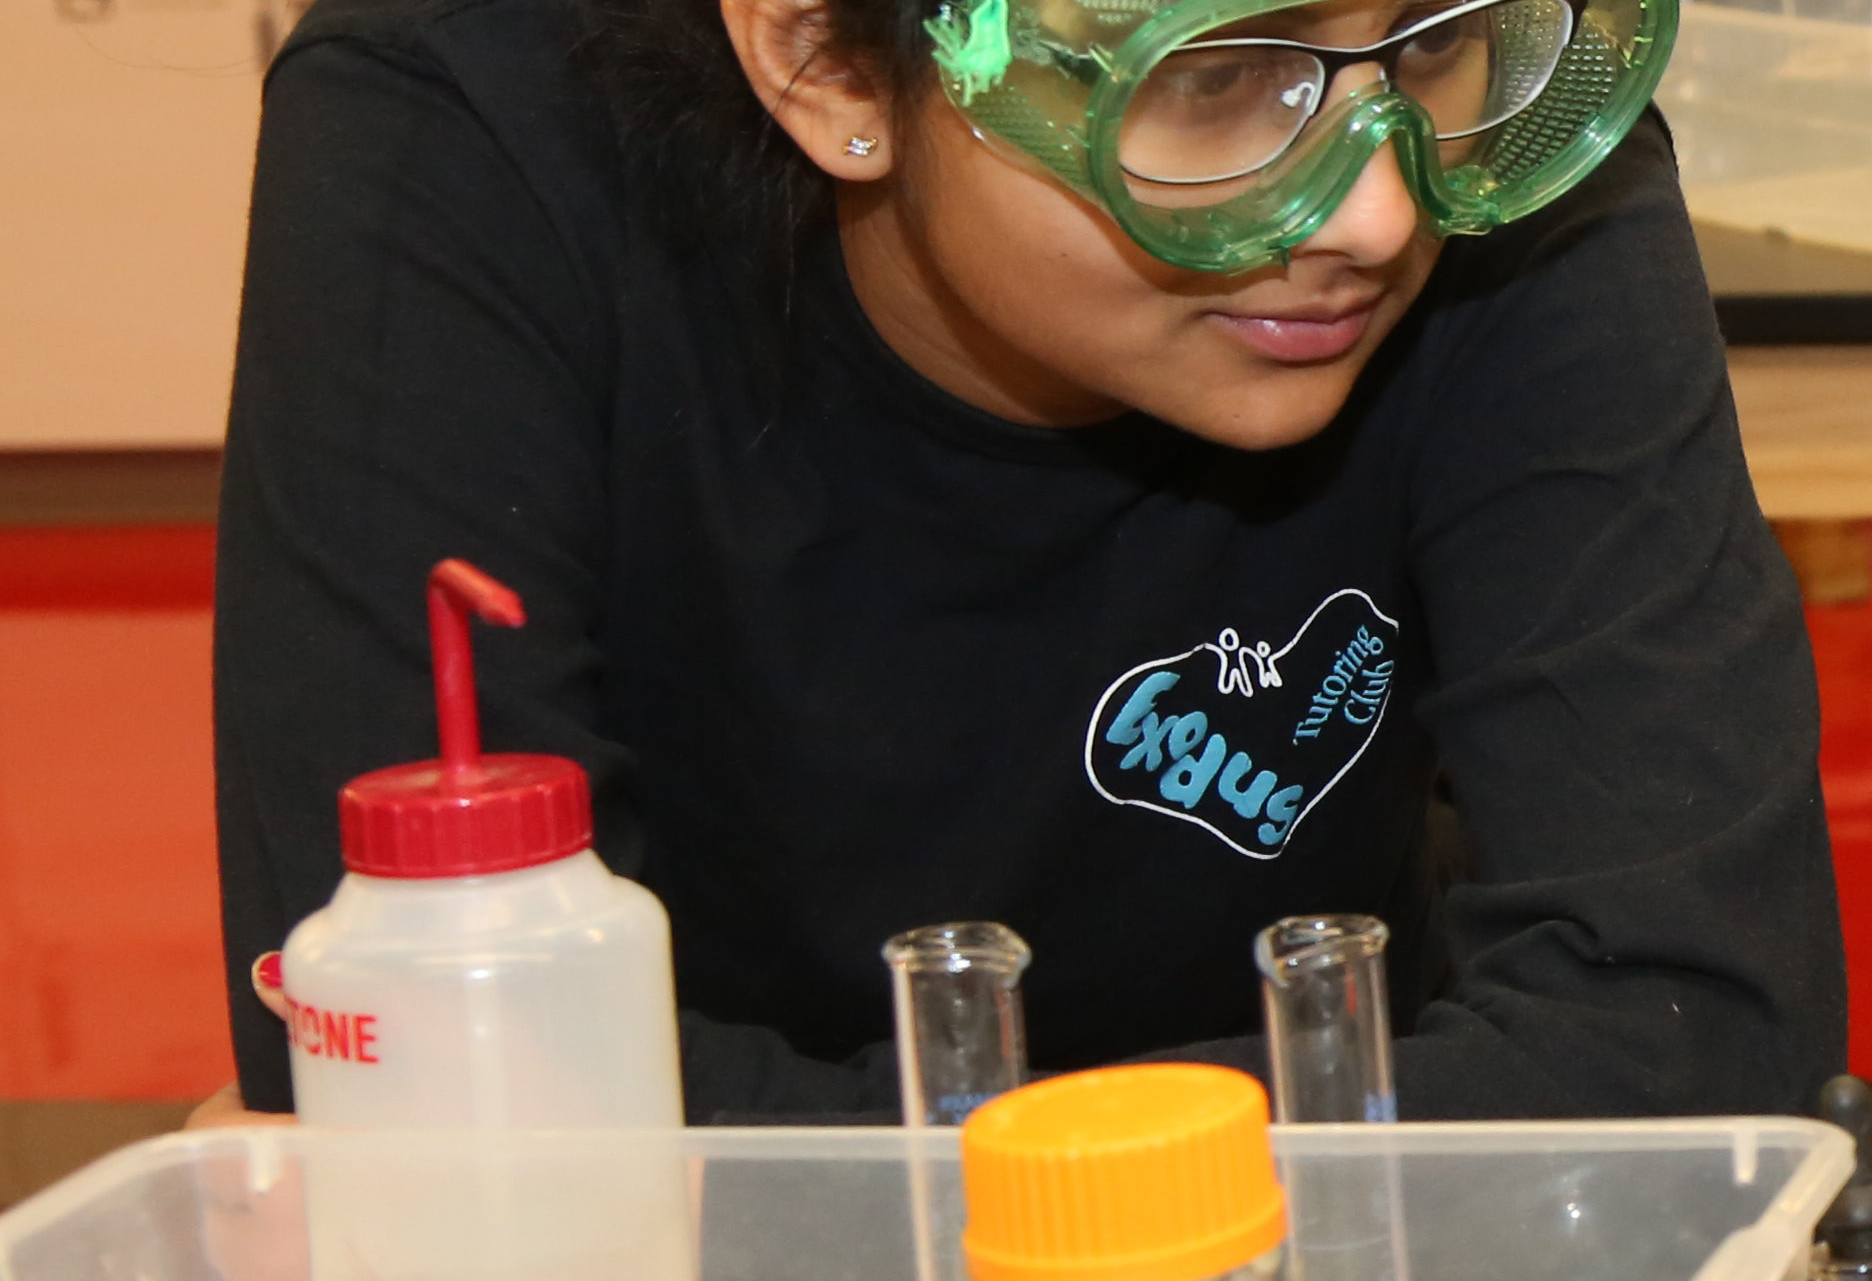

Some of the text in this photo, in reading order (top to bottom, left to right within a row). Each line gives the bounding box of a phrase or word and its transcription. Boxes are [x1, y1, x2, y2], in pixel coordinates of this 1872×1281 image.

[1292, 624, 1384, 746] Tutoring
[1344, 660, 1394, 724] Club
[1105, 671, 1303, 845] Exodus
